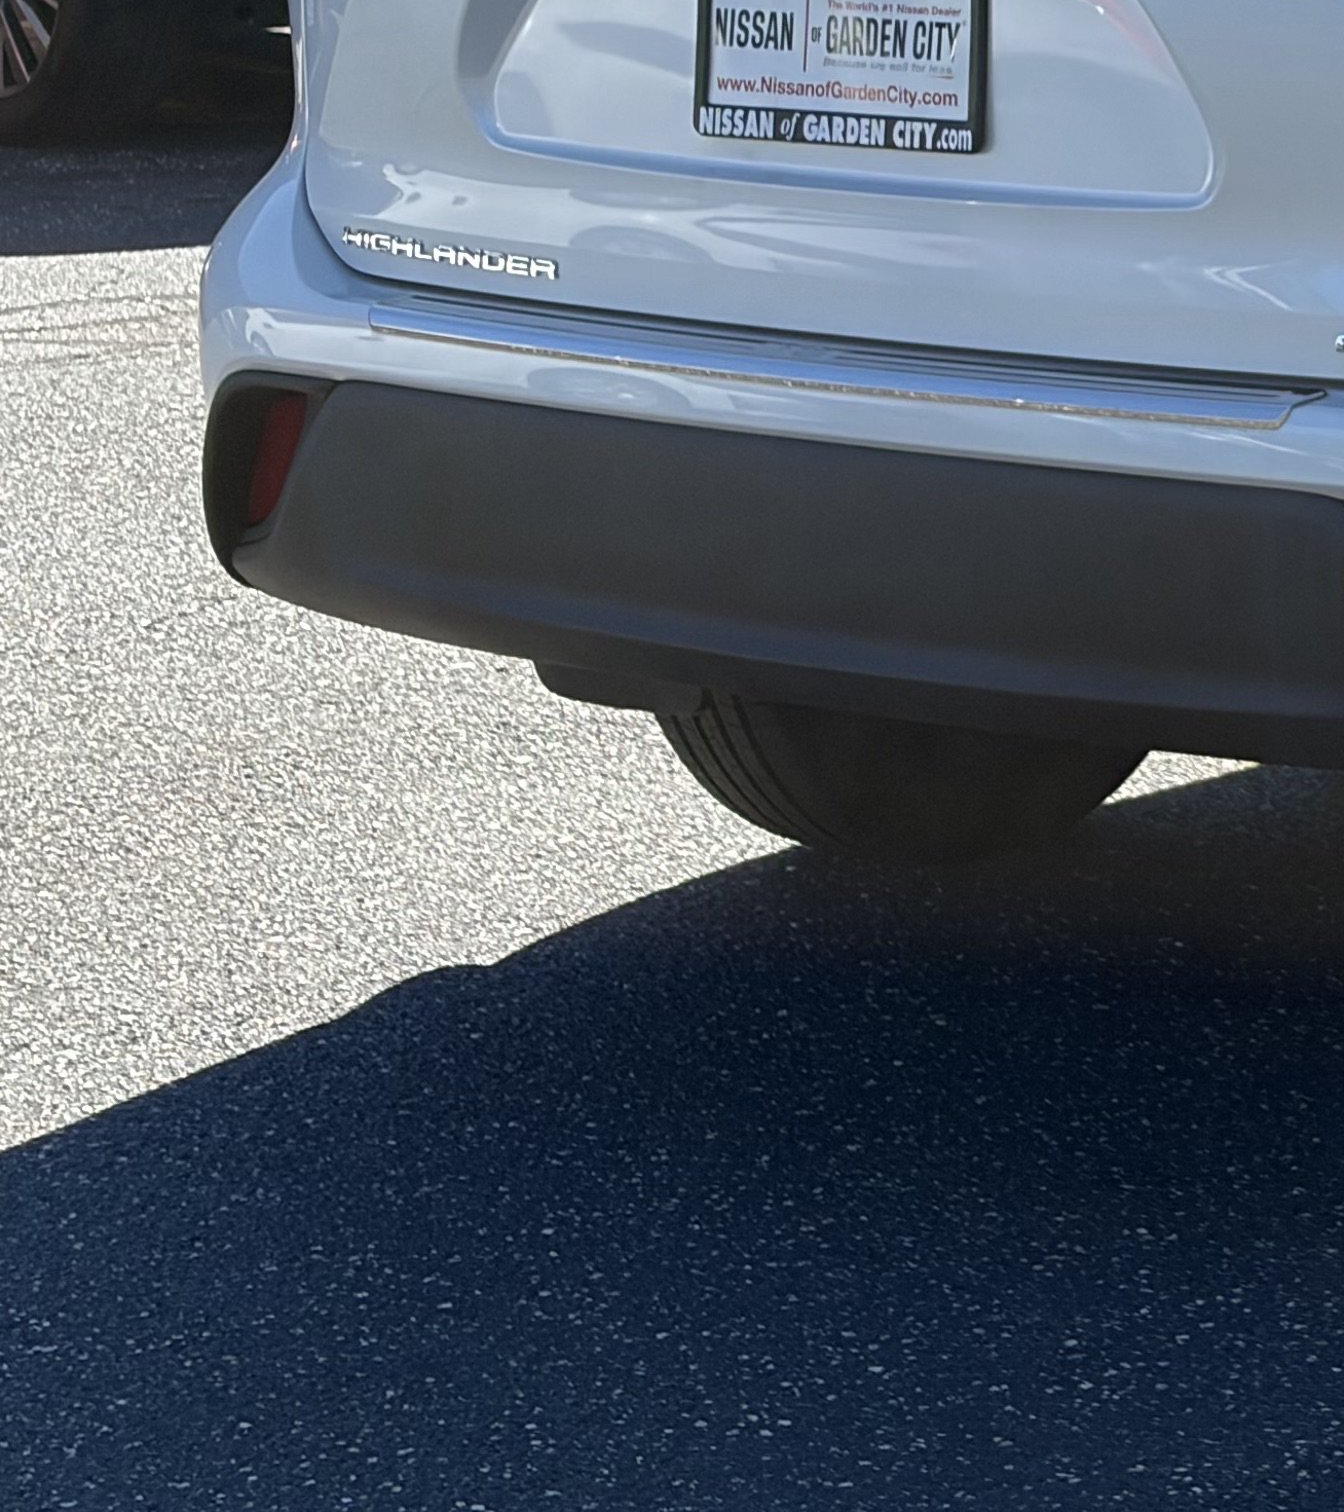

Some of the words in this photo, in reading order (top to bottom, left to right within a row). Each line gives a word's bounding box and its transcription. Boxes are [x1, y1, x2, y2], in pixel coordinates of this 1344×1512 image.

[897, 3, 929, 16] Nissan
[932, 6, 962, 17] Dealer
[715, 7, 794, 51] NISSAN
[811, 26, 822, 44] OF
[826, 14, 908, 58] GARDEN
[912, 19, 961, 62] CITY
[717, 76, 959, 108] www.NissanofGardenCity.com
[699, 106, 775, 138] NISSAN
[780, 112, 800, 140] of
[803, 114, 886, 147] GARDEN
[893, 121, 973, 152] CITY.com
[342, 226, 560, 280] HIGHLANDER
